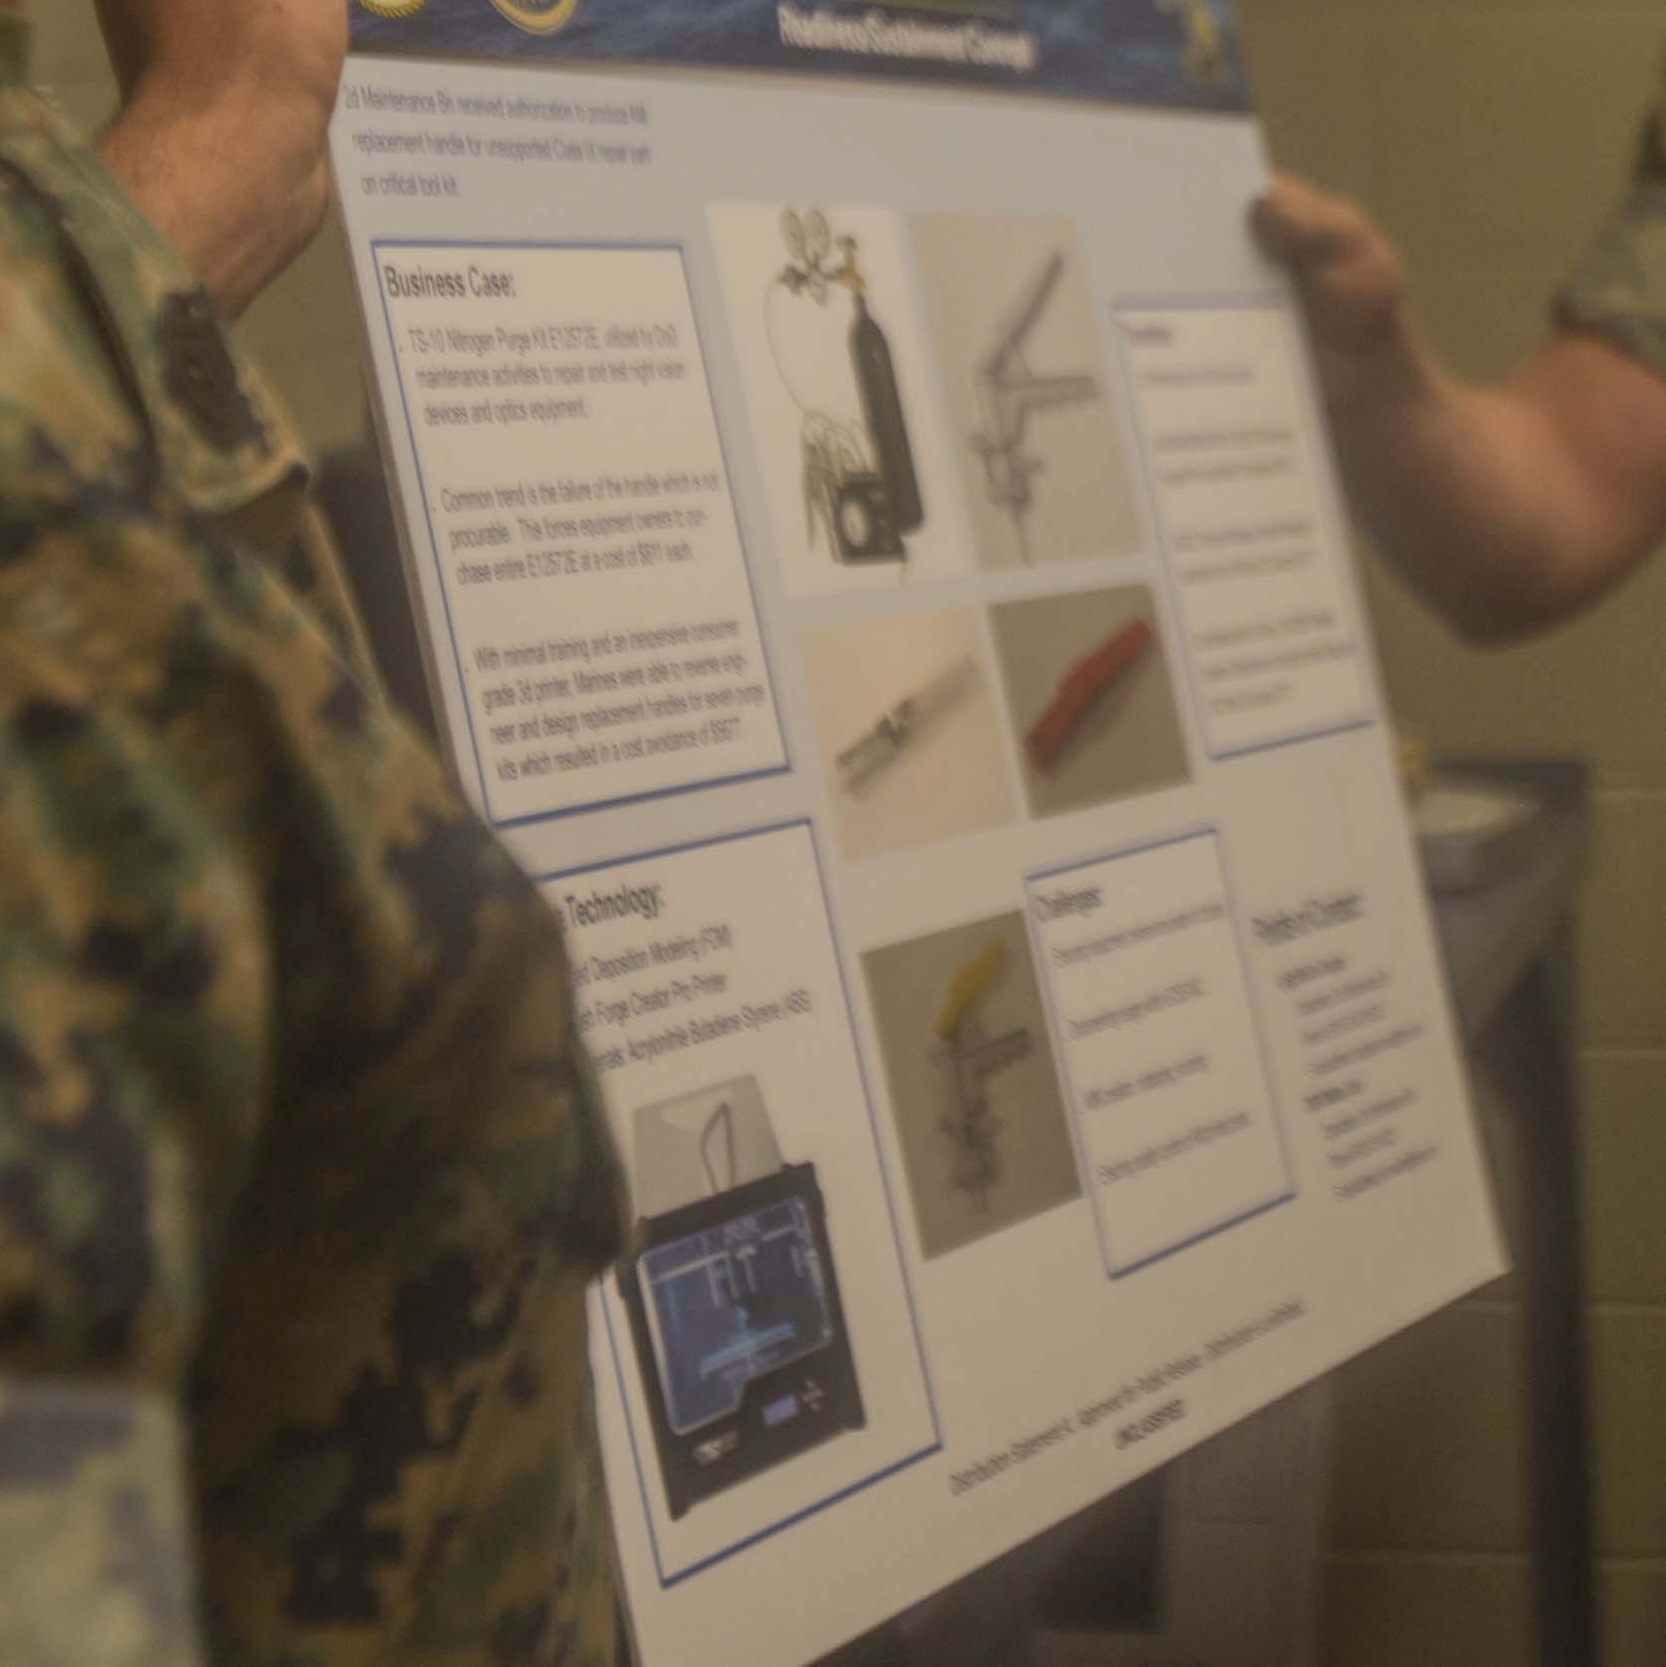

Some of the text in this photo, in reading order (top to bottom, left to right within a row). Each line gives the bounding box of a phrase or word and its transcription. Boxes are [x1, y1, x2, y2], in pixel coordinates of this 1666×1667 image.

[343, 86, 359, 109] 2d
[360, 86, 437, 114] Maintenance
[352, 130, 425, 154] replacement
[426, 132, 464, 156] handle
[465, 135, 482, 157] for
[551, 137, 583, 162] Class
[360, 176, 376, 195] on
[379, 174, 417, 196] critical
[419, 175, 440, 196] tool
[383, 266, 517, 298] Business Case:
[407, 329, 445, 353] TS-10
[445, 329, 494, 358] Nitrogen
[495, 329, 530, 358] Purge
[416, 366, 490, 388] maintenance
[492, 364, 540, 386] activities
[553, 363, 583, 389] repair
[424, 402, 469, 426] devices
[471, 399, 493, 424] and
[494, 398, 527, 426] optics
[441, 487, 494, 512] Common
[495, 482, 525, 508] trend
[539, 482, 557, 505] the
[624, 474, 660, 497] handle
[516, 518, 542, 542] This
[456, 563, 492, 586] chase
[473, 646, 501, 671] With
[502, 641, 547, 667] minimal
[547, 638, 590, 664] training
[590, 631, 612, 656] and
[483, 686, 516, 716] grade
[572, 671, 618, 694] Marines
[618, 667, 645, 687] were
[517, 717, 541, 740] and
[541, 714, 578, 741] design
[579, 699, 645, 731] replacement
[564, 882, 666, 928] Technology:
[591, 949, 650, 982] Deposition
